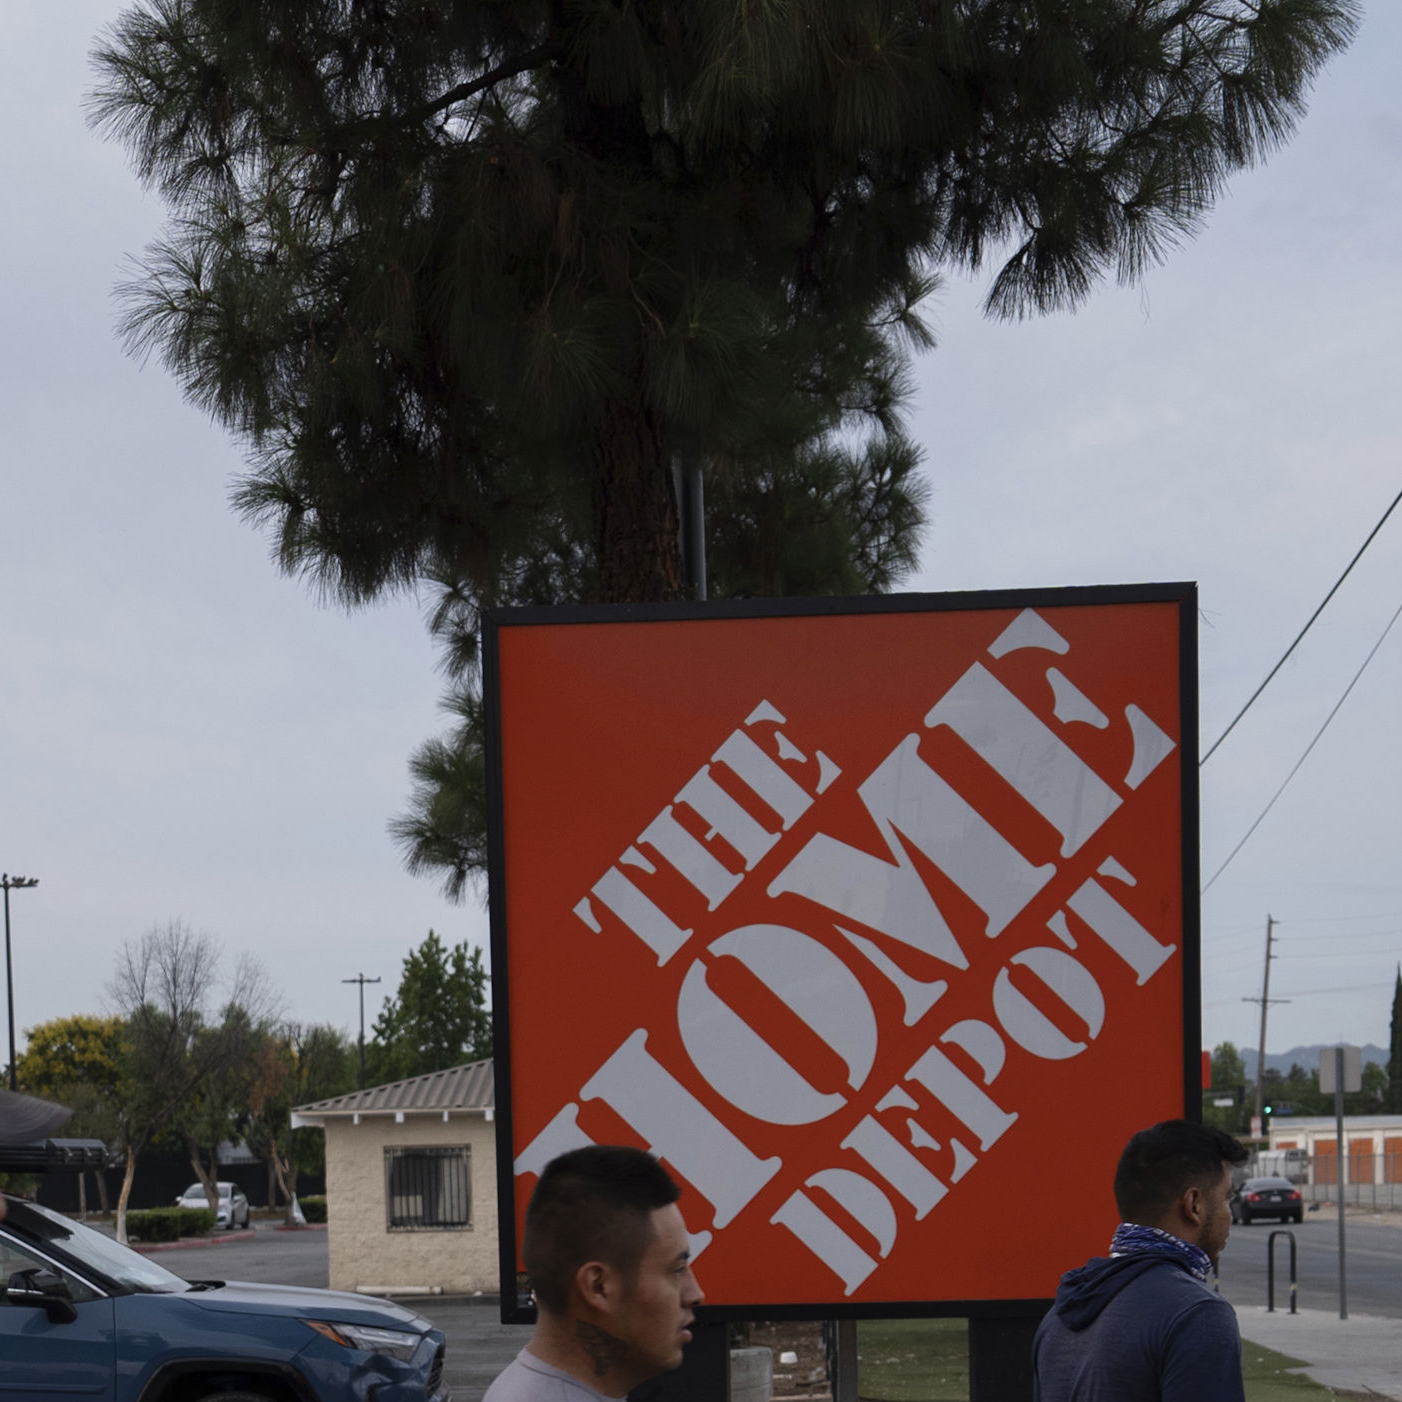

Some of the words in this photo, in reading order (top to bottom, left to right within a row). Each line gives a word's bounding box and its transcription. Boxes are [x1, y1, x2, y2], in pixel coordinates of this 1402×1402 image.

[514, 608, 1177, 1267] HOME
[572, 699, 843, 967] THE
[770, 855, 1177, 1297] DEPOT
